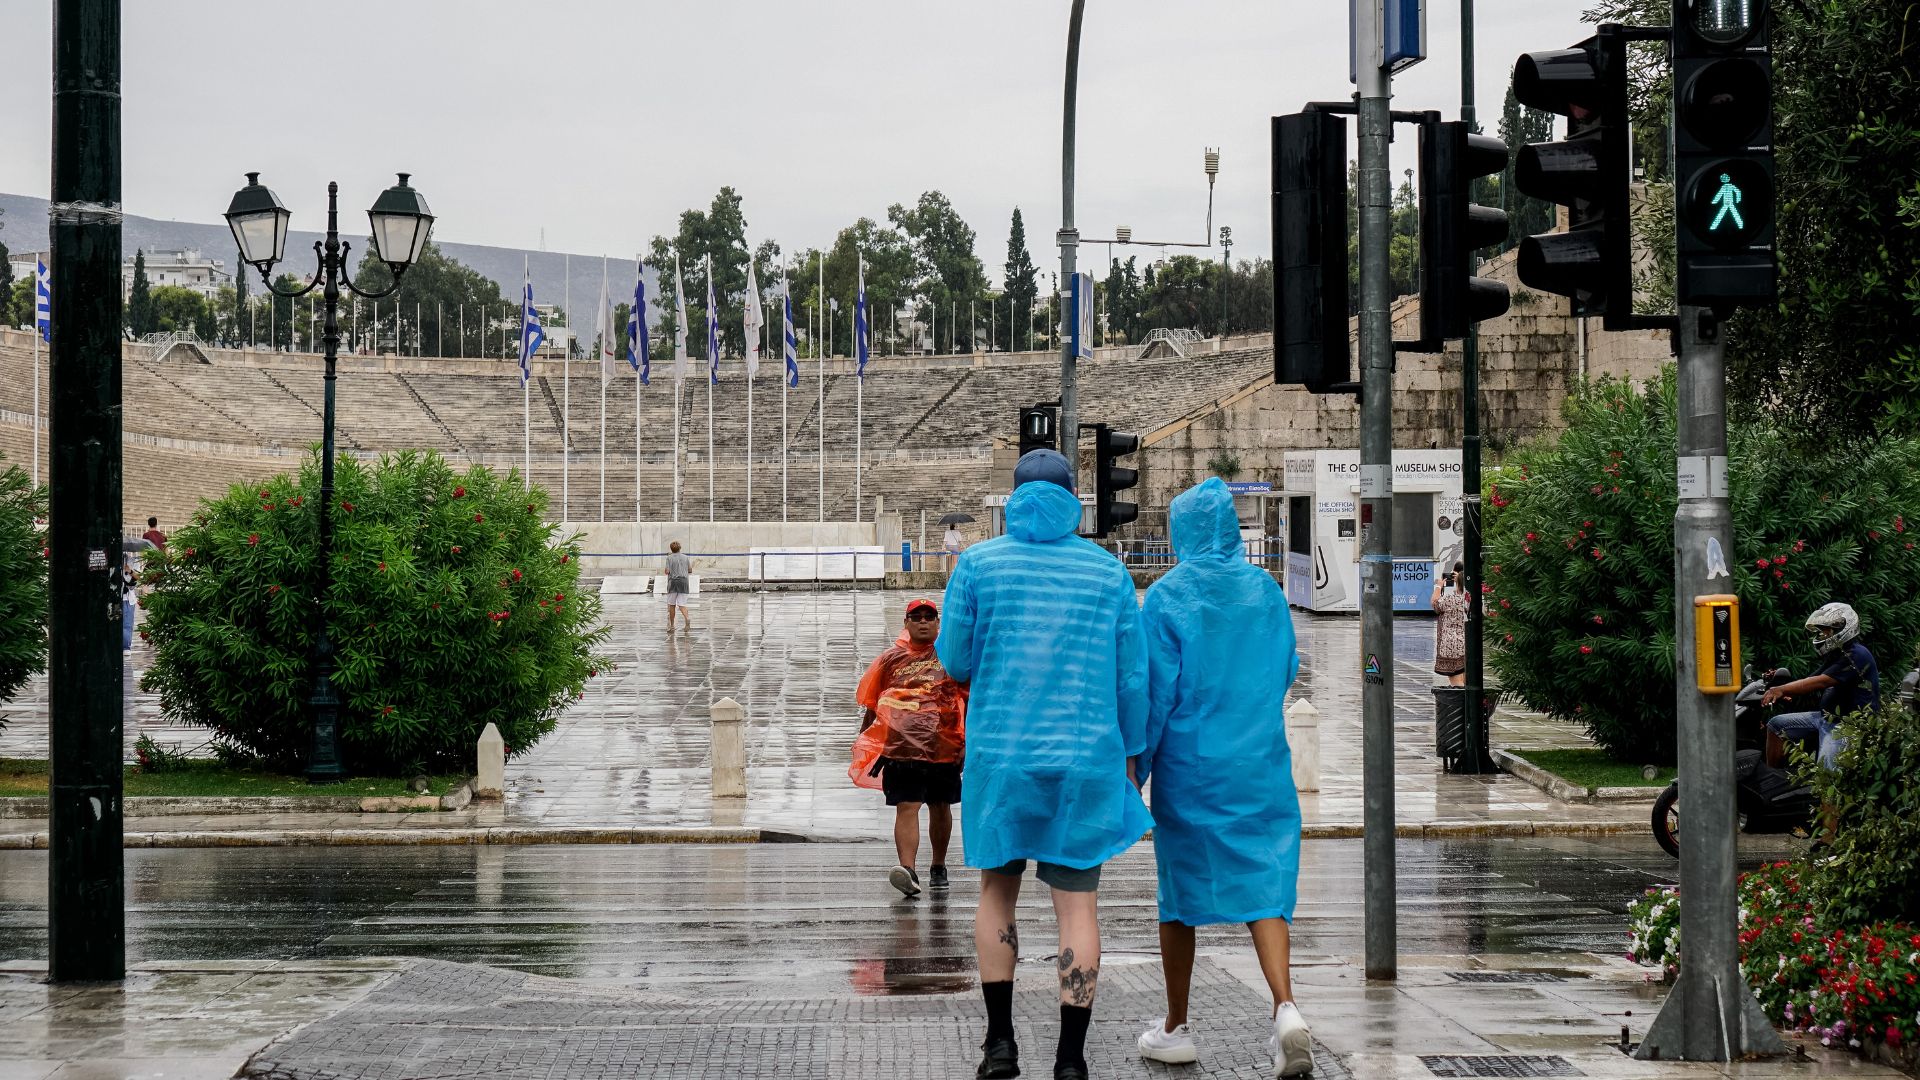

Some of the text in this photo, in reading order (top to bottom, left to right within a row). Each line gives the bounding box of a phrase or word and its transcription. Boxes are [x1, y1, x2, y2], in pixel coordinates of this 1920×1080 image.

[1328, 463, 1346, 473] THE
[1395, 463, 1437, 473] MUSEUM
[1439, 463, 1463, 473] SHO
[1448, 506, 1464, 514] histo
[1392, 562, 1429, 572] FFICIAL
[1403, 572, 1429, 581] SHOP
